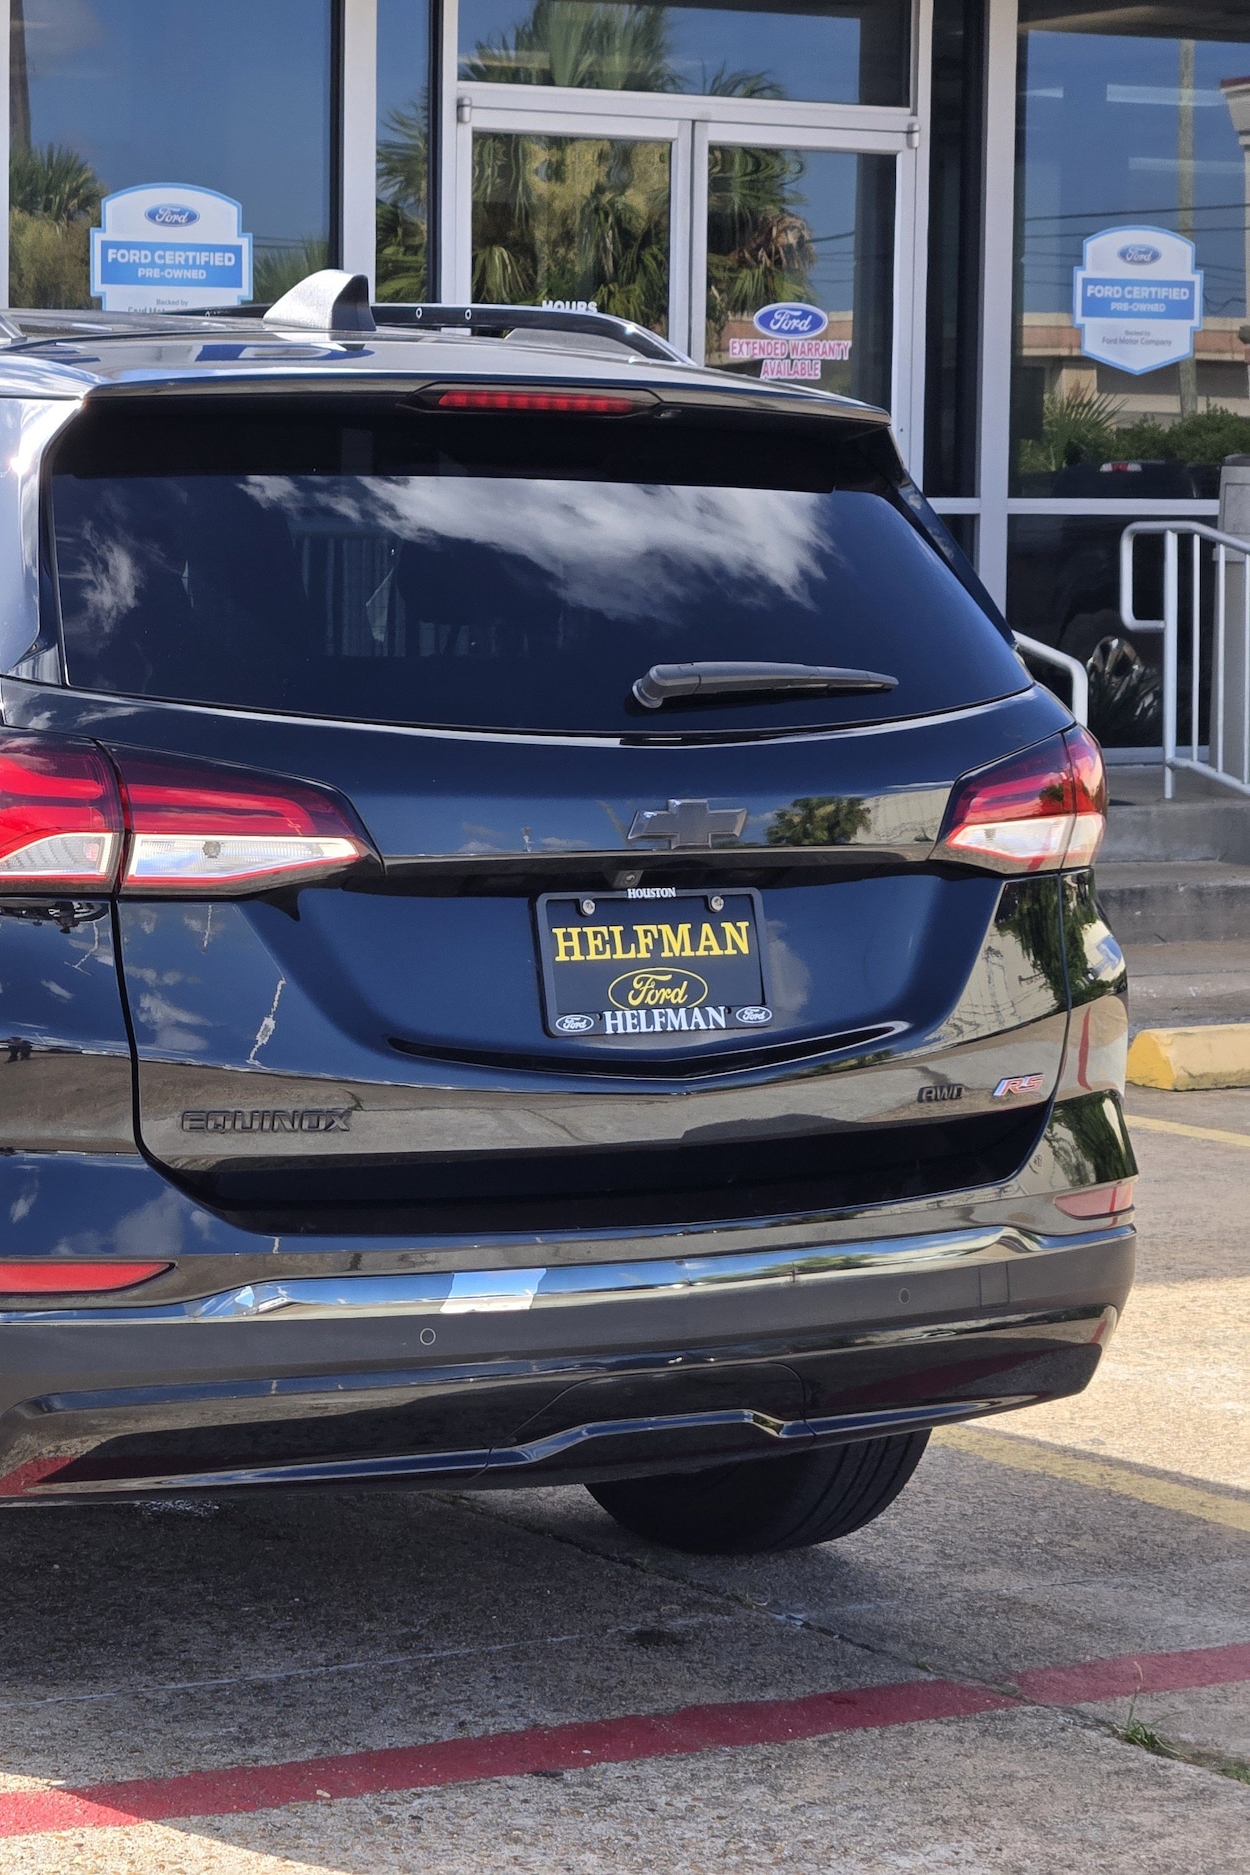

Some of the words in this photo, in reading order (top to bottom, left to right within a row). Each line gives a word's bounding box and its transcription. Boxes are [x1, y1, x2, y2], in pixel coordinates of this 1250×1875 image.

[155, 207, 189, 224] Ford
[107, 249, 152, 264] FORD
[154, 250, 236, 266] CERTIFIED
[1125, 246, 1154, 262] Ford
[137, 268, 207, 280] PRE-OWNED
[1086, 285, 1122, 298] FORD
[1123, 286, 1190, 300] CERTIFIED
[156, 298, 180, 306] Backed
[181, 299, 188, 307] by
[1110, 302, 1167, 313] PRE-OWNED
[769, 309, 812, 331] Ford
[1102, 336, 1118, 345] Ford
[731, 340, 787, 357] EXTENDED
[790, 341, 851, 359] WARRANTY
[761, 360, 820, 378] AVAILABLE
[627, 887, 676, 899] HOUSTON
[552, 921, 750, 962] HELFMAN
[628, 973, 688, 1006] Ford
[603, 1006, 727, 1035] HELFMAN
[742, 1007, 766, 1021] Ford
[562, 1016, 587, 1030] Ford
[917, 1083, 965, 1103] AWD
[995, 1073, 1045, 1096] RS
[182, 1109, 353, 1134] EQUINOX
